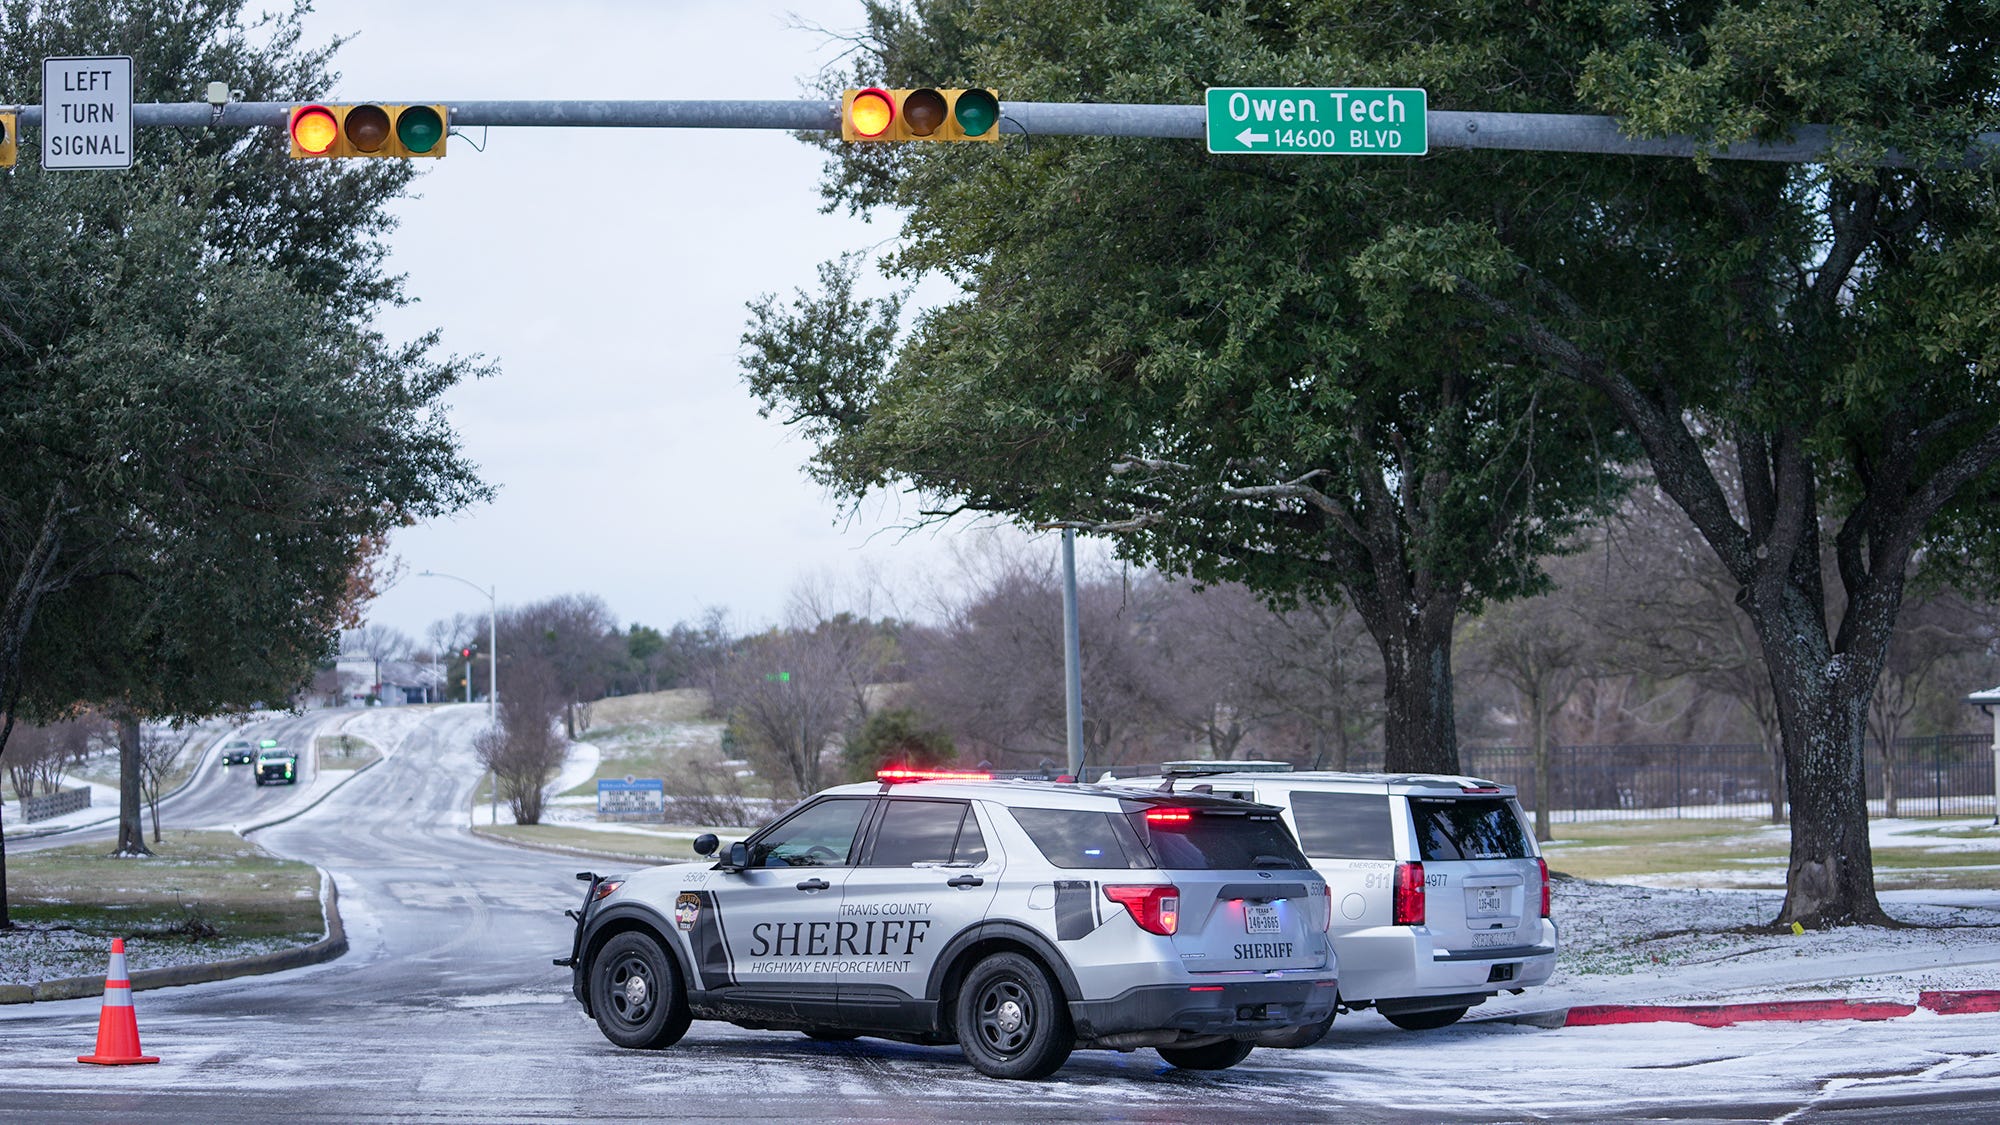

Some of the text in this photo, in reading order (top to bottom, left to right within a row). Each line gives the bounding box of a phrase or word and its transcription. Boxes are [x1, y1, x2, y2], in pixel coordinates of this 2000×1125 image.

[64, 71, 112, 91] LEFT
[61, 103, 114, 124] TURN
[1228, 92, 1406, 123] Owen Tech
[51, 135, 126, 156] SIGNAL
[1274, 129, 1402, 148] 14600 BLVD
[683, 871, 708, 882] 5506
[1365, 872, 1391, 888] 911
[1425, 873, 1448, 887] 4977
[841, 902, 932, 916] TRAVIS COUNTY
[749, 919, 932, 957] SHERIFF
[1233, 942, 1293, 960] SHERIFF
[751, 960, 911, 974] HIGHWAY ENFORCEMENT
